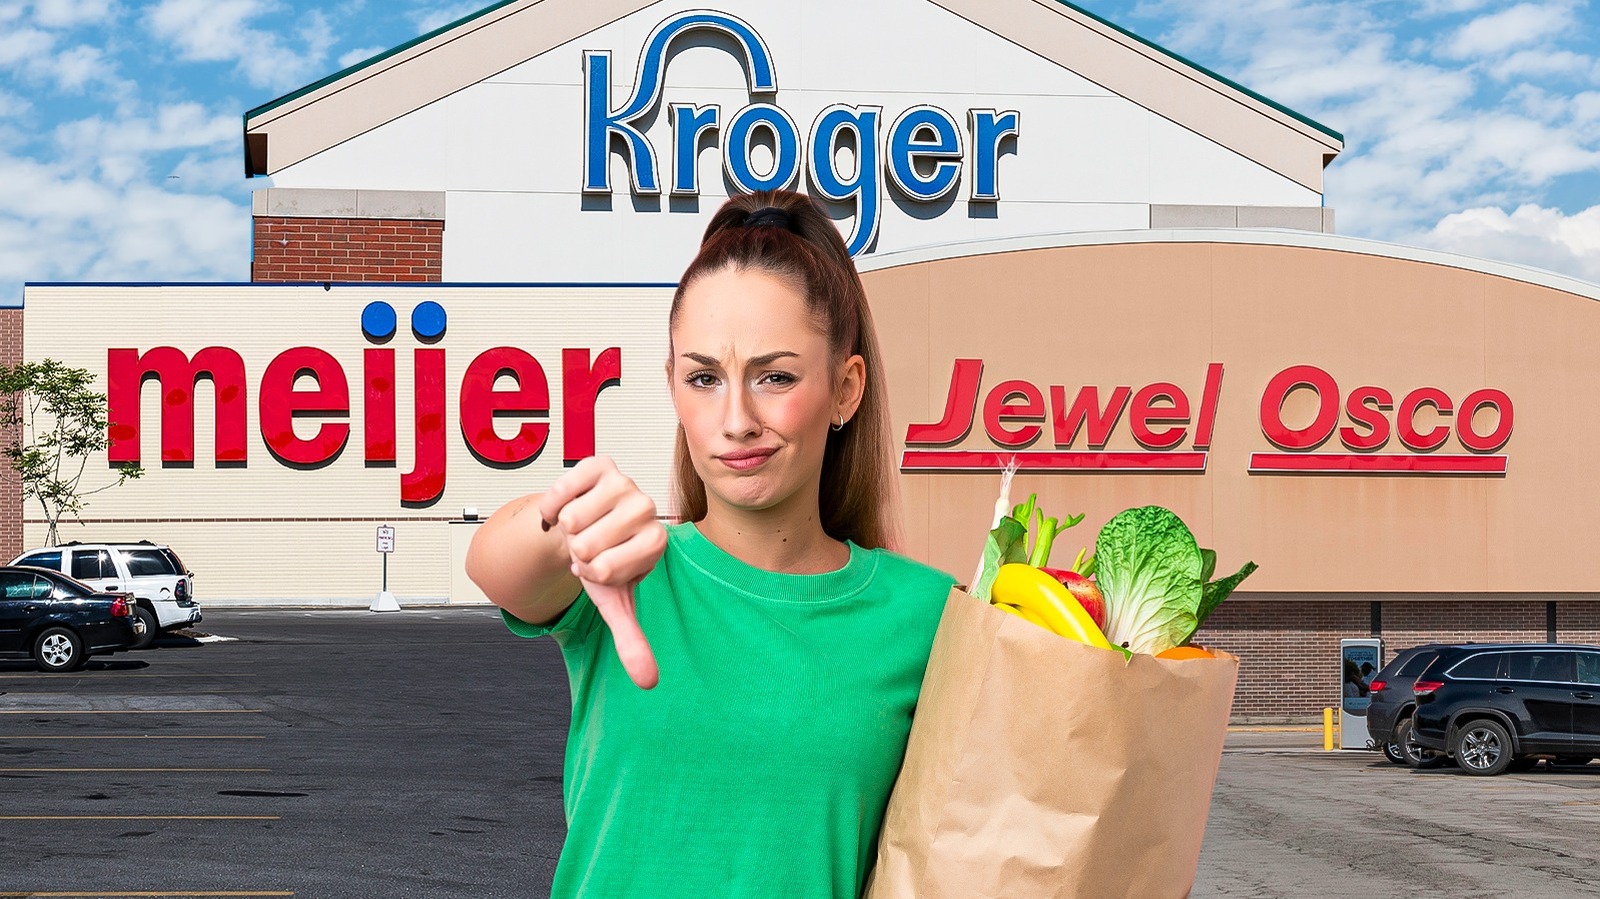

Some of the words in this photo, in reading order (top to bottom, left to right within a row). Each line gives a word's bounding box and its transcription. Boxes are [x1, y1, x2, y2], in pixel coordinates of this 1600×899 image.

[582, 9, 1021, 257] Kroger
[107, 300, 622, 507] meijer
[905, 357, 1224, 451] Jewel
[1259, 363, 1515, 453] Osco
